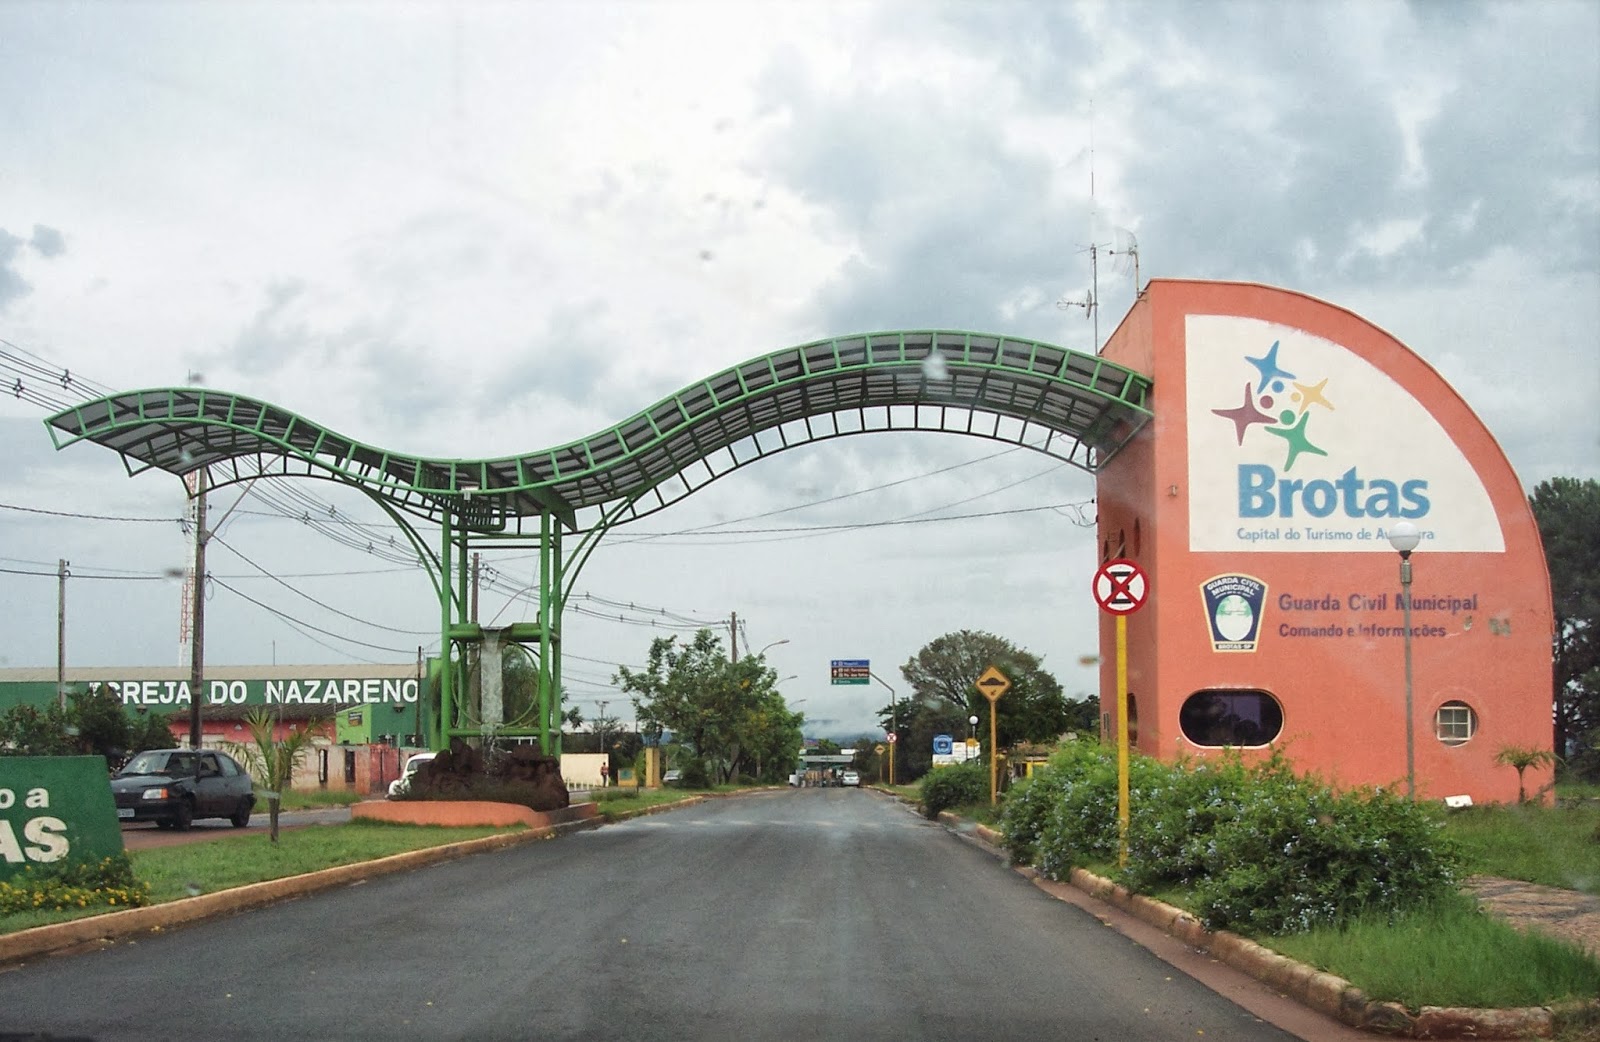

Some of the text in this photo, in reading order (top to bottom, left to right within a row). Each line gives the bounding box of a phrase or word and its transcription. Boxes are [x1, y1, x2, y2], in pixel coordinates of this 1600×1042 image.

[1238, 463, 1431, 519] Brotas
[1237, 527, 1435, 543] Capital do Turismo de Avra
[1206, 577, 1260, 591] GUARDA CIVIL
[1211, 584, 1255, 596] MUNICIPAL
[1279, 593, 1478, 615] Guarda Civil Municipal
[1279, 623, 1343, 637] Comando
[1346, 627, 1355, 637] e
[210, 681, 248, 704] DO
[266, 679, 418, 704] NAZARENO
[25, 787, 50, 809] a
